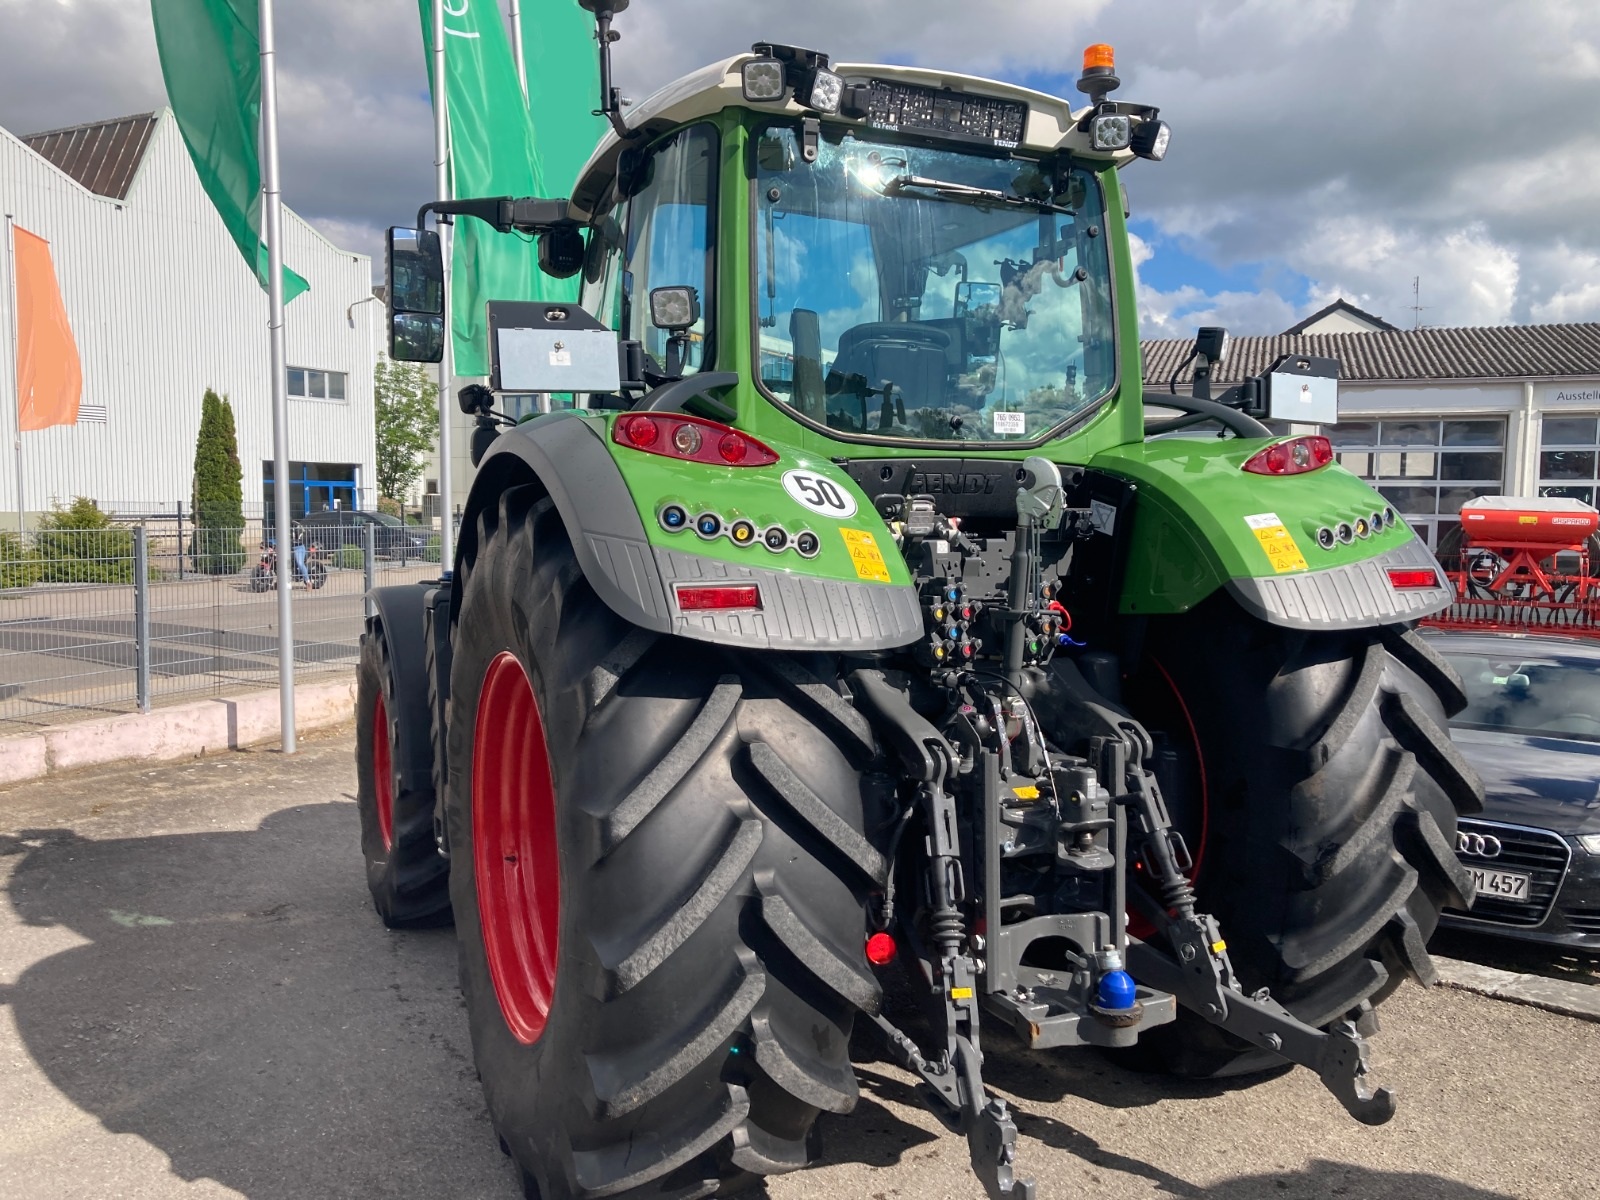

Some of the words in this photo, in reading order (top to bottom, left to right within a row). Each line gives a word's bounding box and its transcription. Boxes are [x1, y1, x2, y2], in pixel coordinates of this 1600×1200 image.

[994, 139, 1019, 148] FENDT
[792, 475, 846, 510] 50
[910, 472, 1003, 494] FENDT
[1489, 874, 1526, 896] 457
